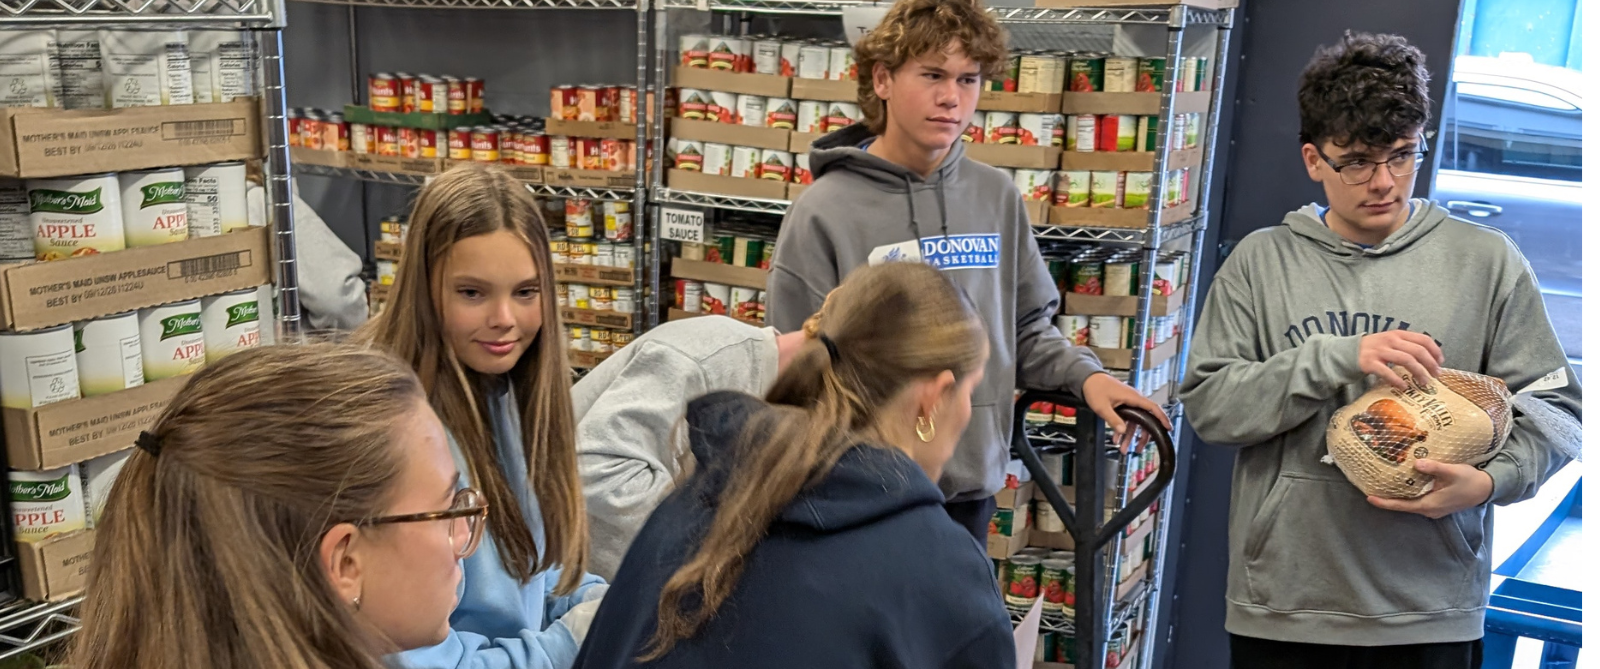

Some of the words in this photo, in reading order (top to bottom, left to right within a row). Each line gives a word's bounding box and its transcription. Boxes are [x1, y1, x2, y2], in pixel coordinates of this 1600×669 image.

[22, 132, 66, 143] MOTHER'S
[44, 146, 67, 157] BEST
[69, 145, 82, 155] BY
[63, 194, 97, 210] Maid
[153, 213, 187, 230] APPL
[666, 212, 703, 226] TOMATO
[37, 224, 96, 239] APPLE
[669, 228, 699, 241] SAUCE
[49, 238, 79, 247] Sauce
[923, 238, 999, 257] DONOVAN
[29, 281, 72, 296] MOTHER'S
[72, 278, 93, 289] MAID
[118, 265, 167, 281] APPLESAUCE
[46, 295, 69, 308] BEST
[71, 293, 82, 304] BY
[1284, 310, 1443, 348] DONOV
[48, 421, 89, 437] MOTHER'S
[90, 415, 109, 427] MAID
[68, 433, 91, 446] BEST
[92, 429, 104, 440] BY
[9, 483, 37, 494] other's
[33, 480, 65, 499] Maid
[14, 509, 66, 526] PPLE
[18, 526, 49, 535] Sauce
[62, 551, 92, 567] MOTHE
